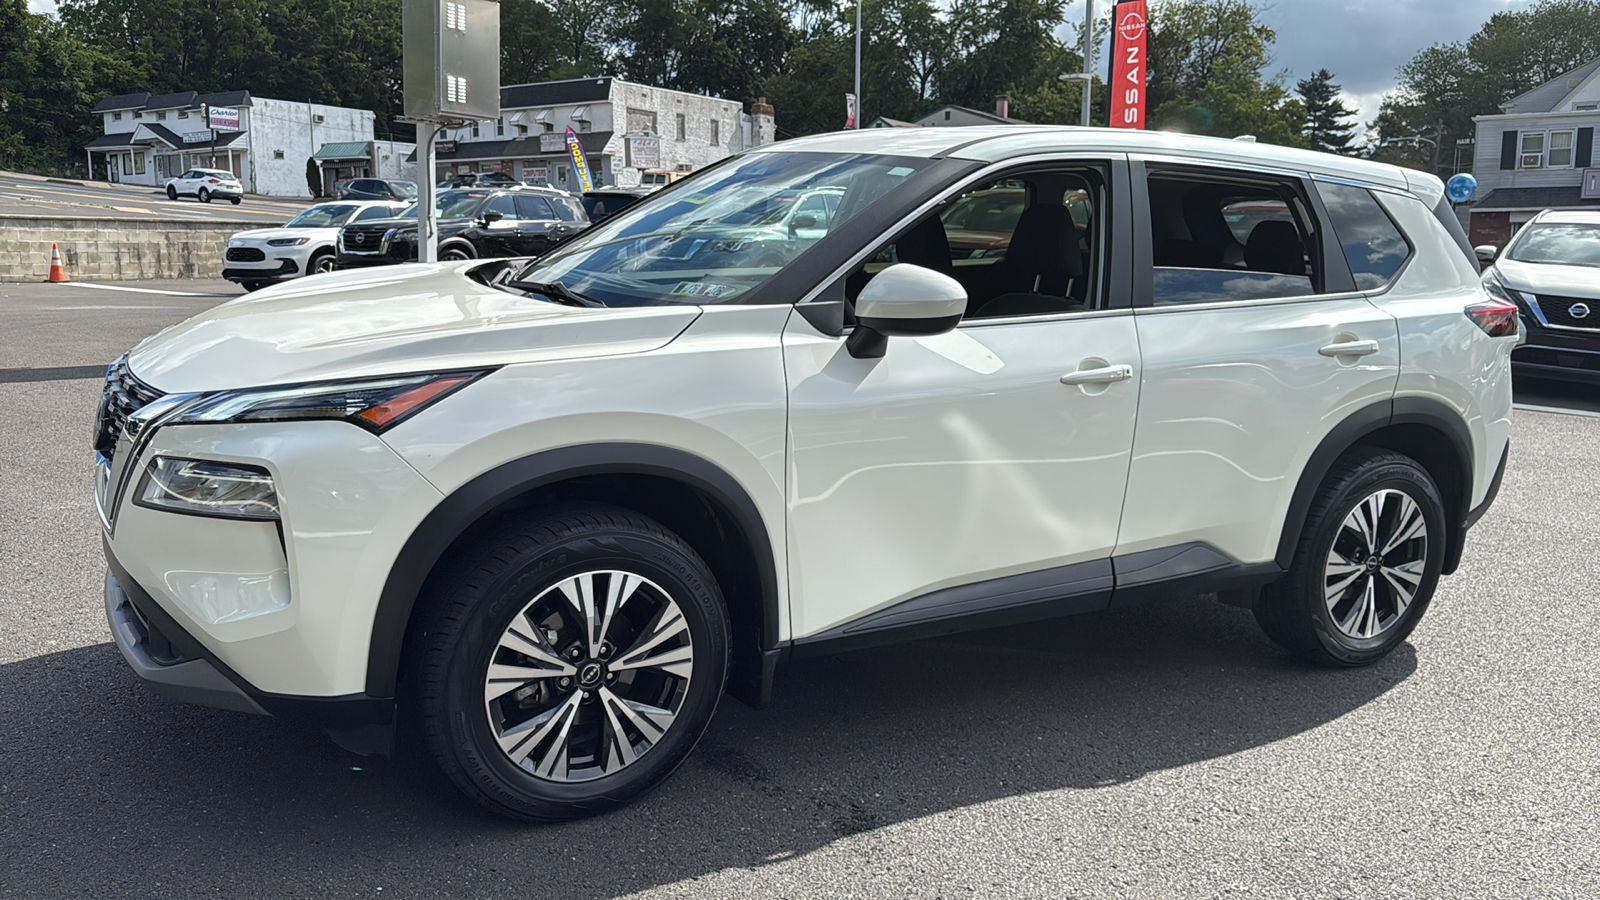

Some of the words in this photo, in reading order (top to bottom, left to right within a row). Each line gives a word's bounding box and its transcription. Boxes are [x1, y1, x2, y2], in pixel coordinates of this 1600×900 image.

[1119, 23, 1145, 31] NISSAN
[1124, 47, 1139, 124] SSAN
[632, 146, 658, 154] COMPUTERS
[523, 169, 547, 177] COMPUTERS
[685, 572, 701, 591] R18
